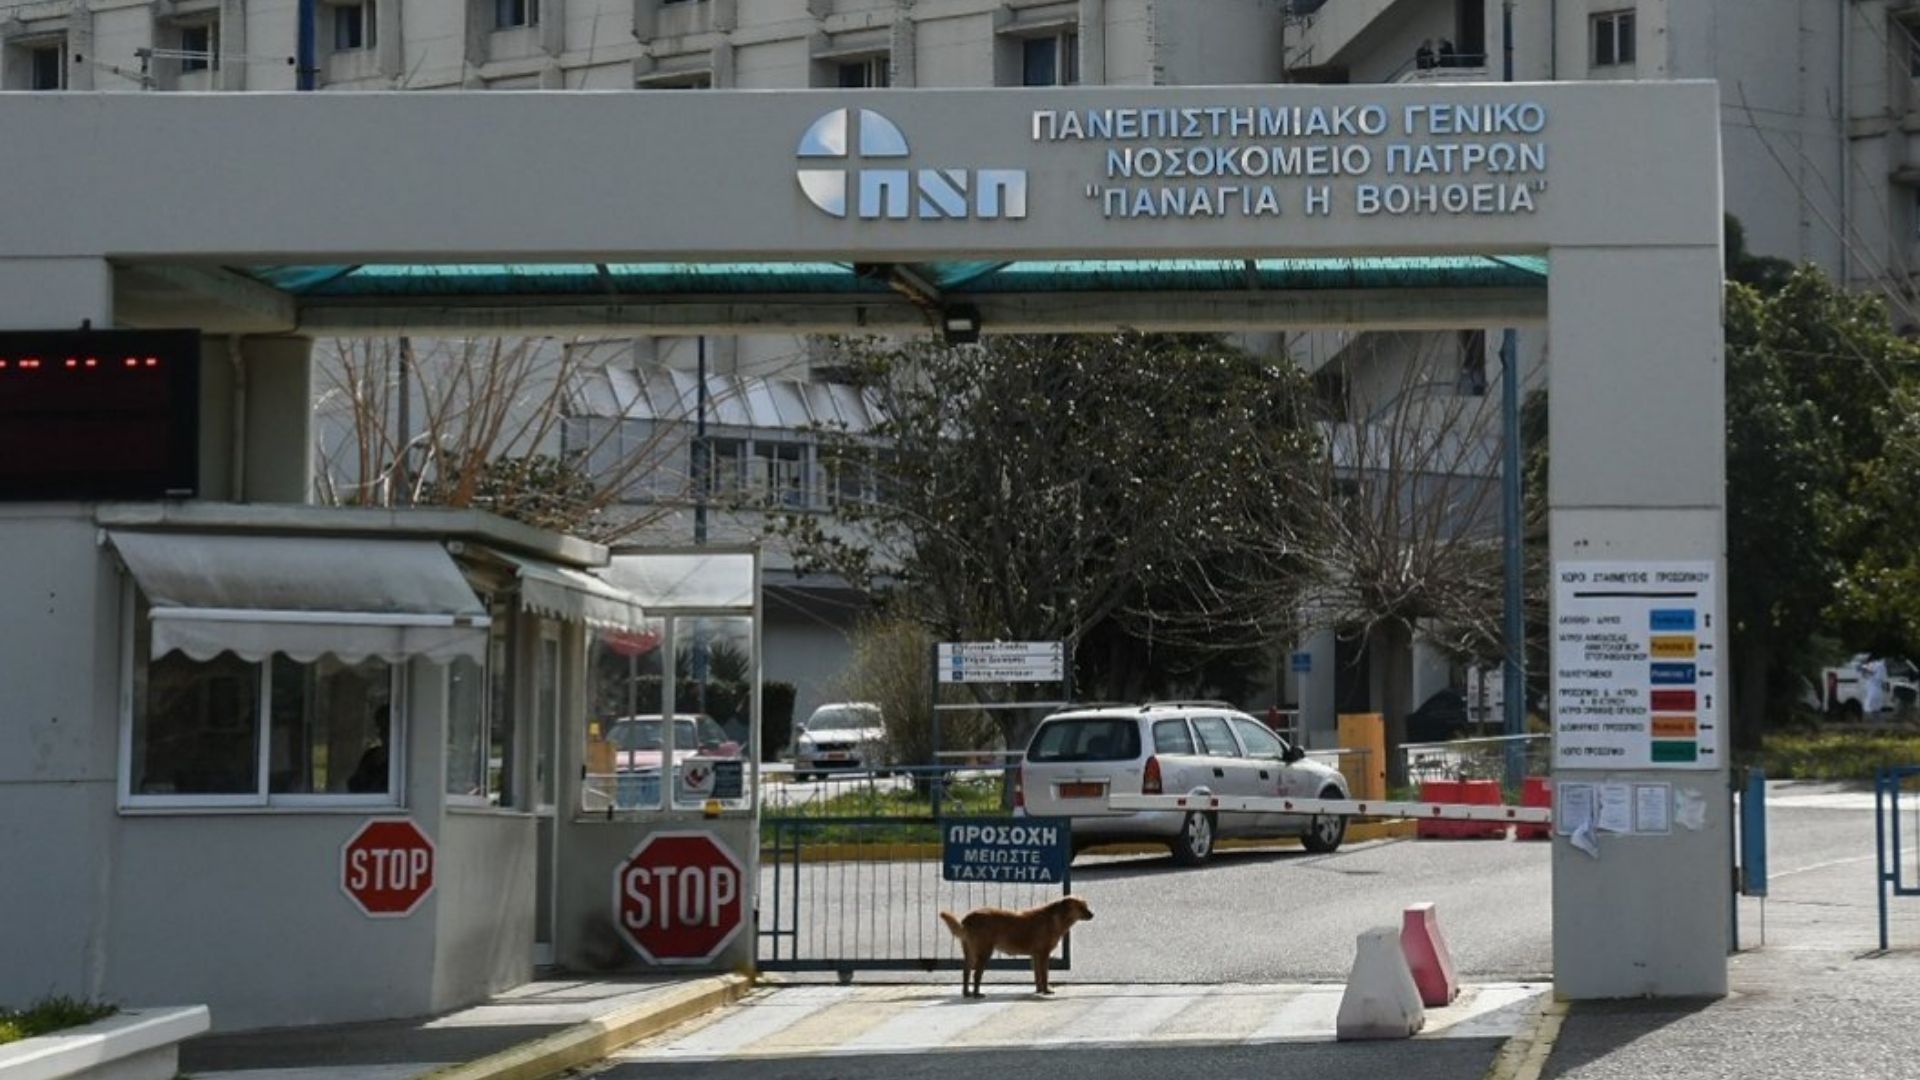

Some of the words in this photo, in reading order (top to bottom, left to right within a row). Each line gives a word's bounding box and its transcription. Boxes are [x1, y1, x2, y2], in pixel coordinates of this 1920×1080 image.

[1031, 105, 1388, 142] ΠΑΝΕΠΙΣΤΗΜΙΑΚΟ
[1404, 102, 1547, 135] ΓΕΝΙΚΟ
[1107, 145, 1371, 177] ΝΟΣΟΚΟΜΕΙΟ
[1386, 142, 1547, 173] ΠΑΤΡΩΝ
[1085, 183, 1281, 218] "ΠΑΝΑΓΙΑ
[1305, 184, 1330, 215] Η
[1356, 181, 1548, 214] ΒΟΗΘΕΙΑ"
[950, 825, 1057, 846] ΠΡΟΣΟΧΗ
[350, 848, 428, 891] STOP
[951, 864, 1052, 881] ΤΑΧΥΤΗΤΑ
[963, 848, 1041, 864] ΜΕΙΩΣΤΕ
[625, 865, 736, 930] STOP
